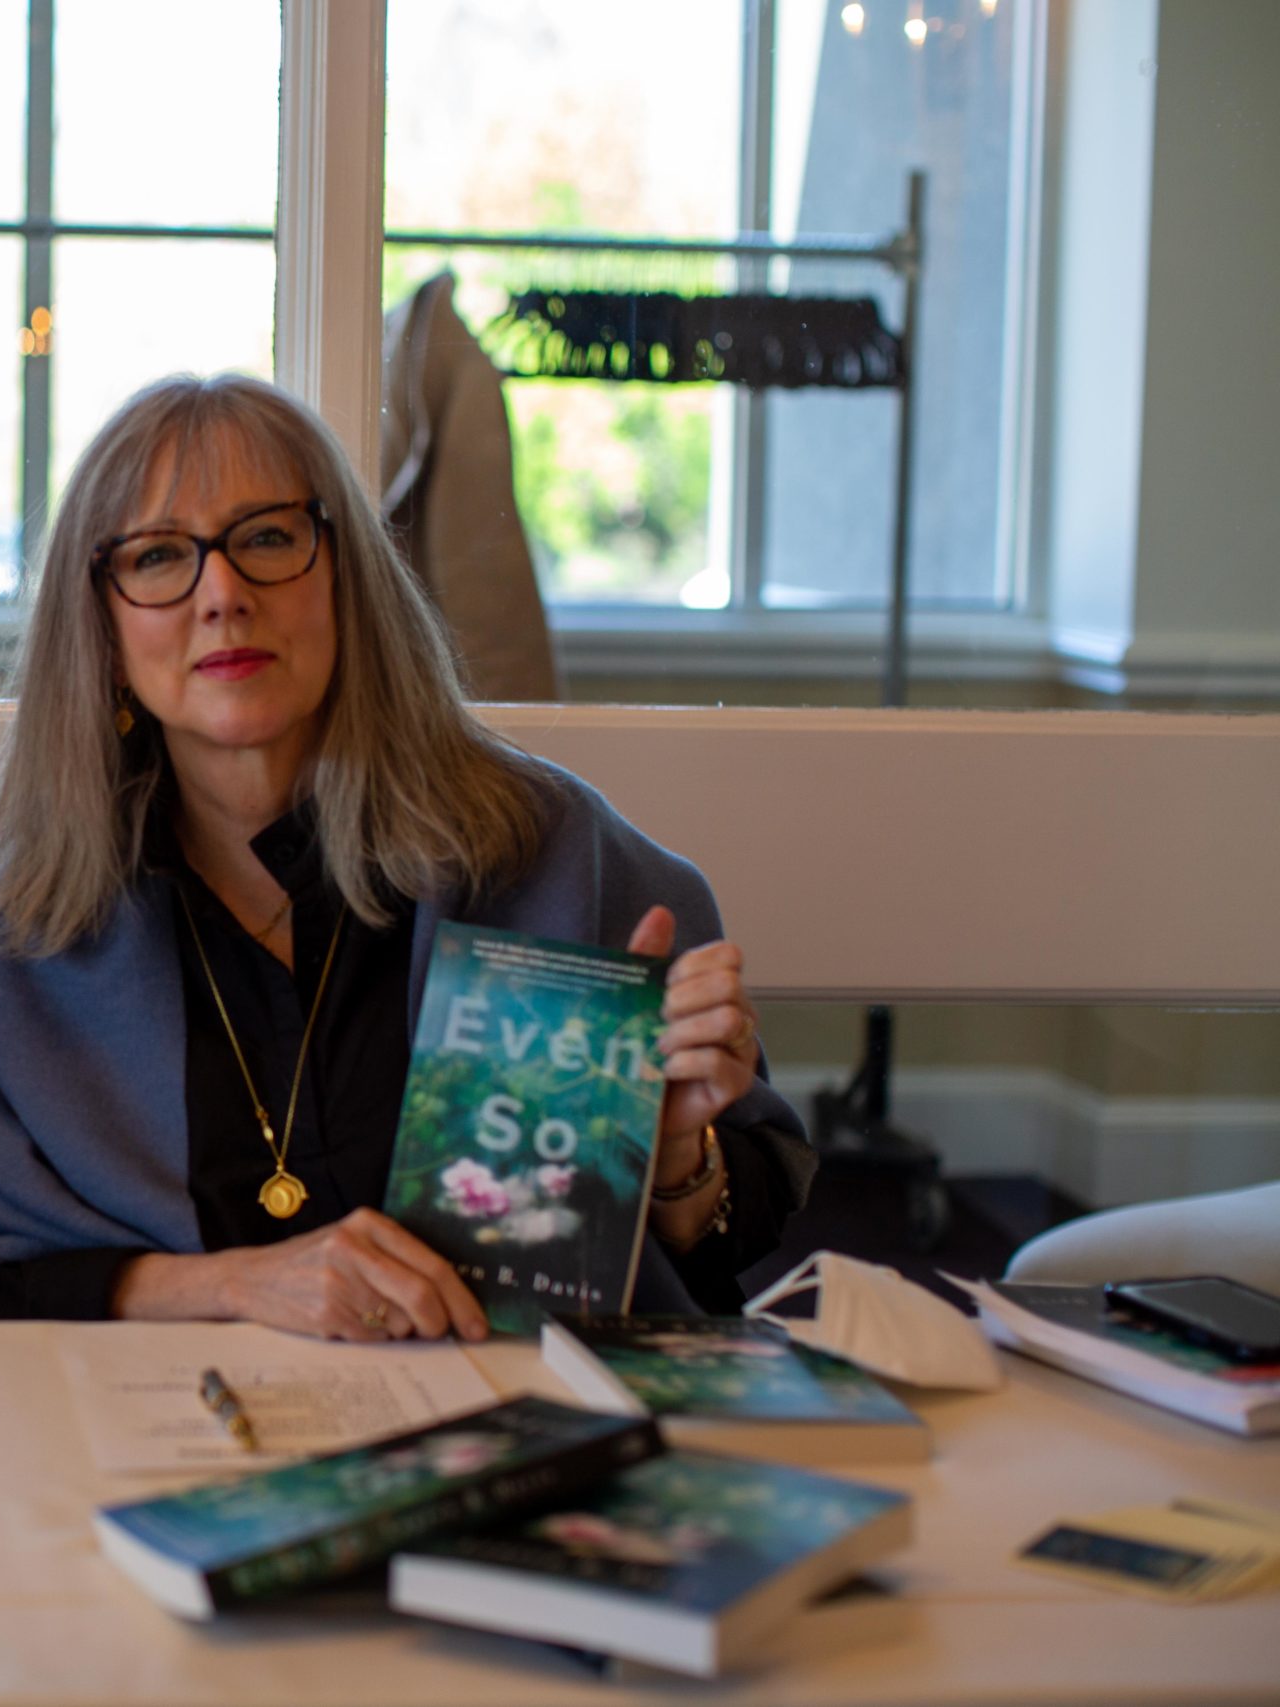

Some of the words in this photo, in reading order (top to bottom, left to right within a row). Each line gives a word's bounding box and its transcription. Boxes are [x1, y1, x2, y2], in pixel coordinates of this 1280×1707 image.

[443, 994, 643, 1081] Even
[475, 1095, 578, 1161] So
[498, 1264, 520, 1288] B.
[532, 1271, 602, 1302] Davis
